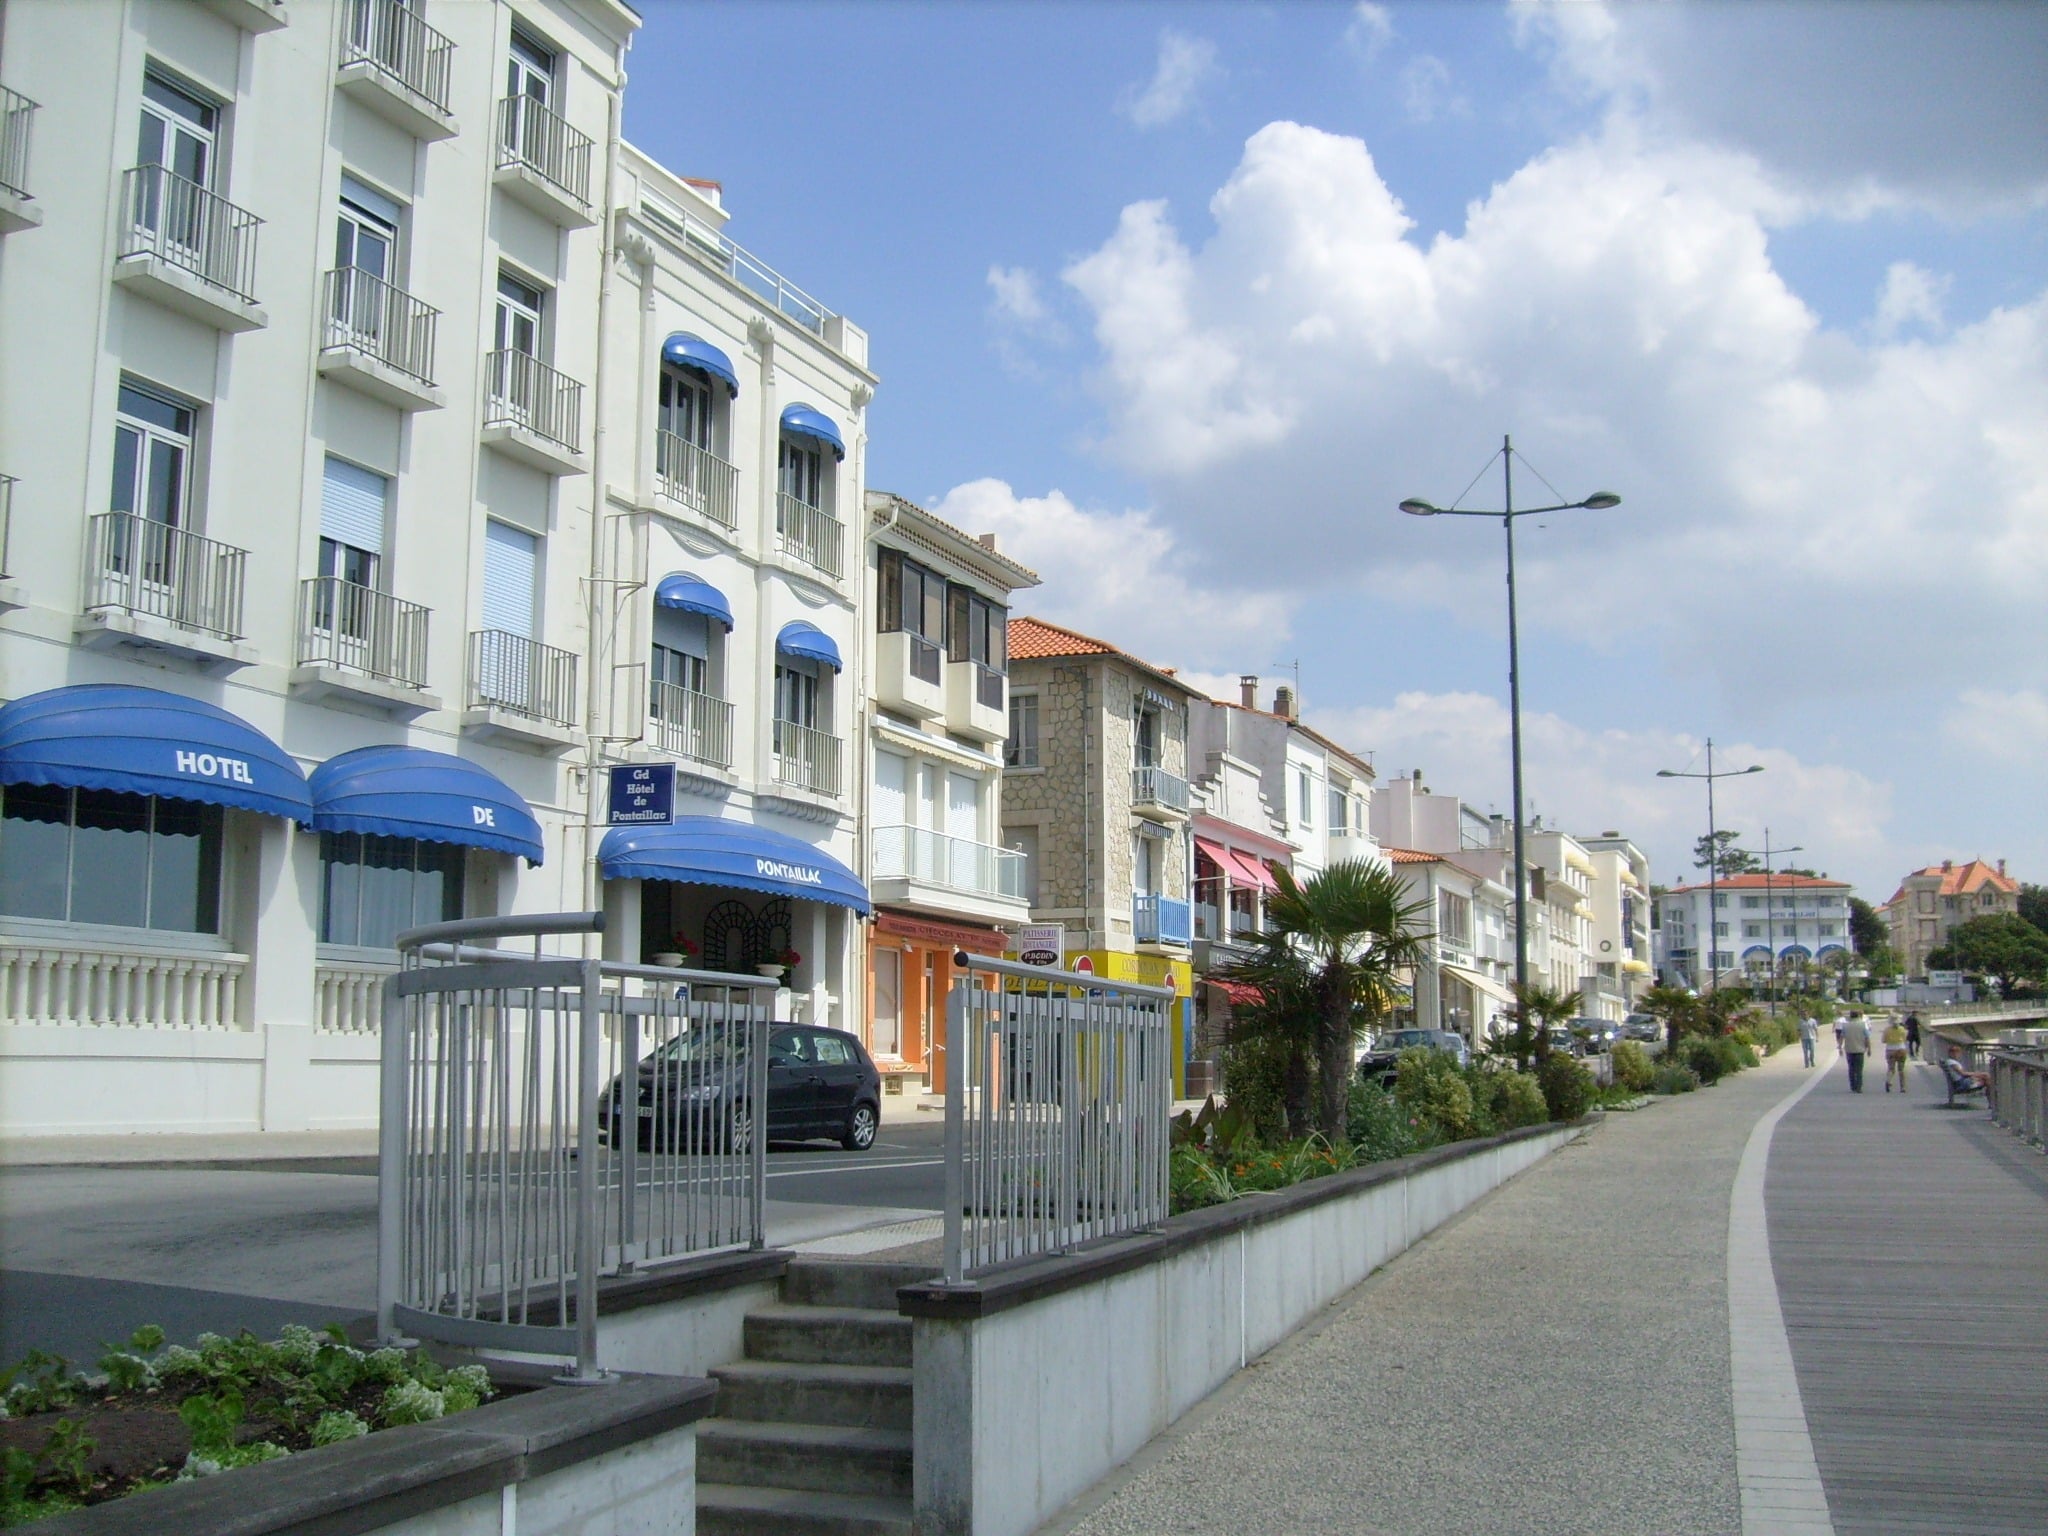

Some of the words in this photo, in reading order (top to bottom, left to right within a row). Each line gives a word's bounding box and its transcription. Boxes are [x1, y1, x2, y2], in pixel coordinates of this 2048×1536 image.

[176, 750, 254, 785] HOTEL
[633, 769, 650, 780] Gd
[626, 782, 655, 794] Hôtel
[633, 795, 647, 806] de
[472, 805, 496, 827] DE
[612, 810, 667, 821] Pontaillac
[756, 859, 822, 885] PONTAILLAC
